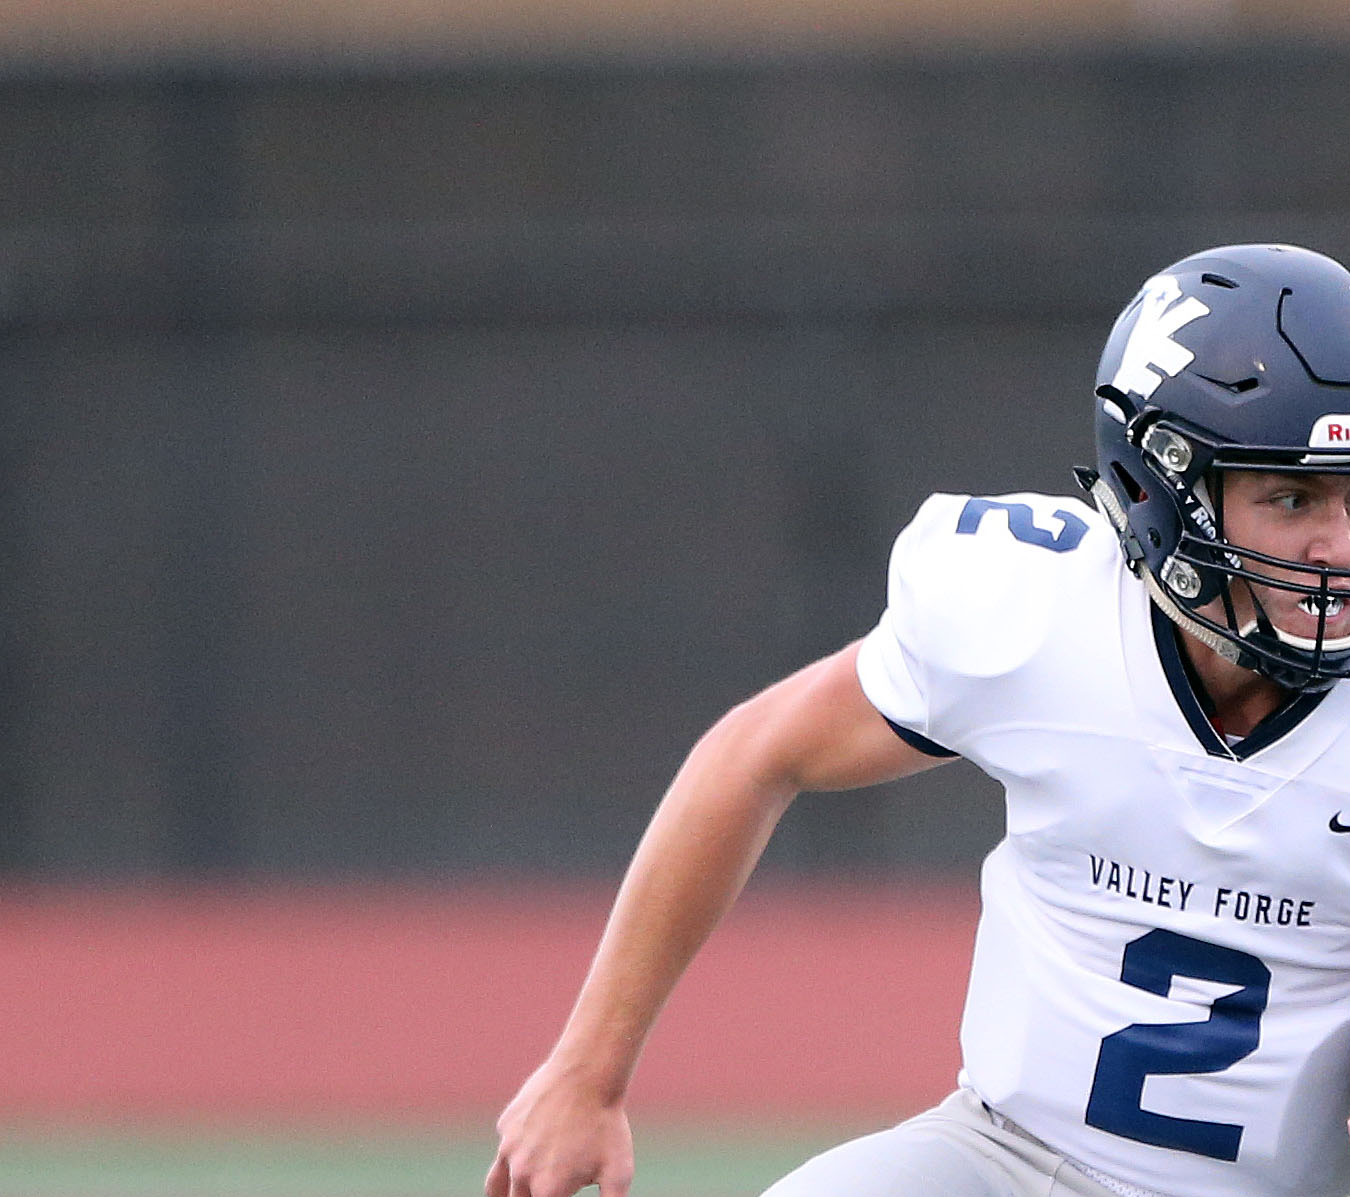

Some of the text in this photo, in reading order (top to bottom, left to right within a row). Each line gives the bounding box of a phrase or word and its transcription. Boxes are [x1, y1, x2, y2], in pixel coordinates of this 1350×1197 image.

[955, 497, 1090, 553] 2
[1089, 854, 1315, 926] VALLEY FORGE
[1085, 928, 1271, 1162] 2
